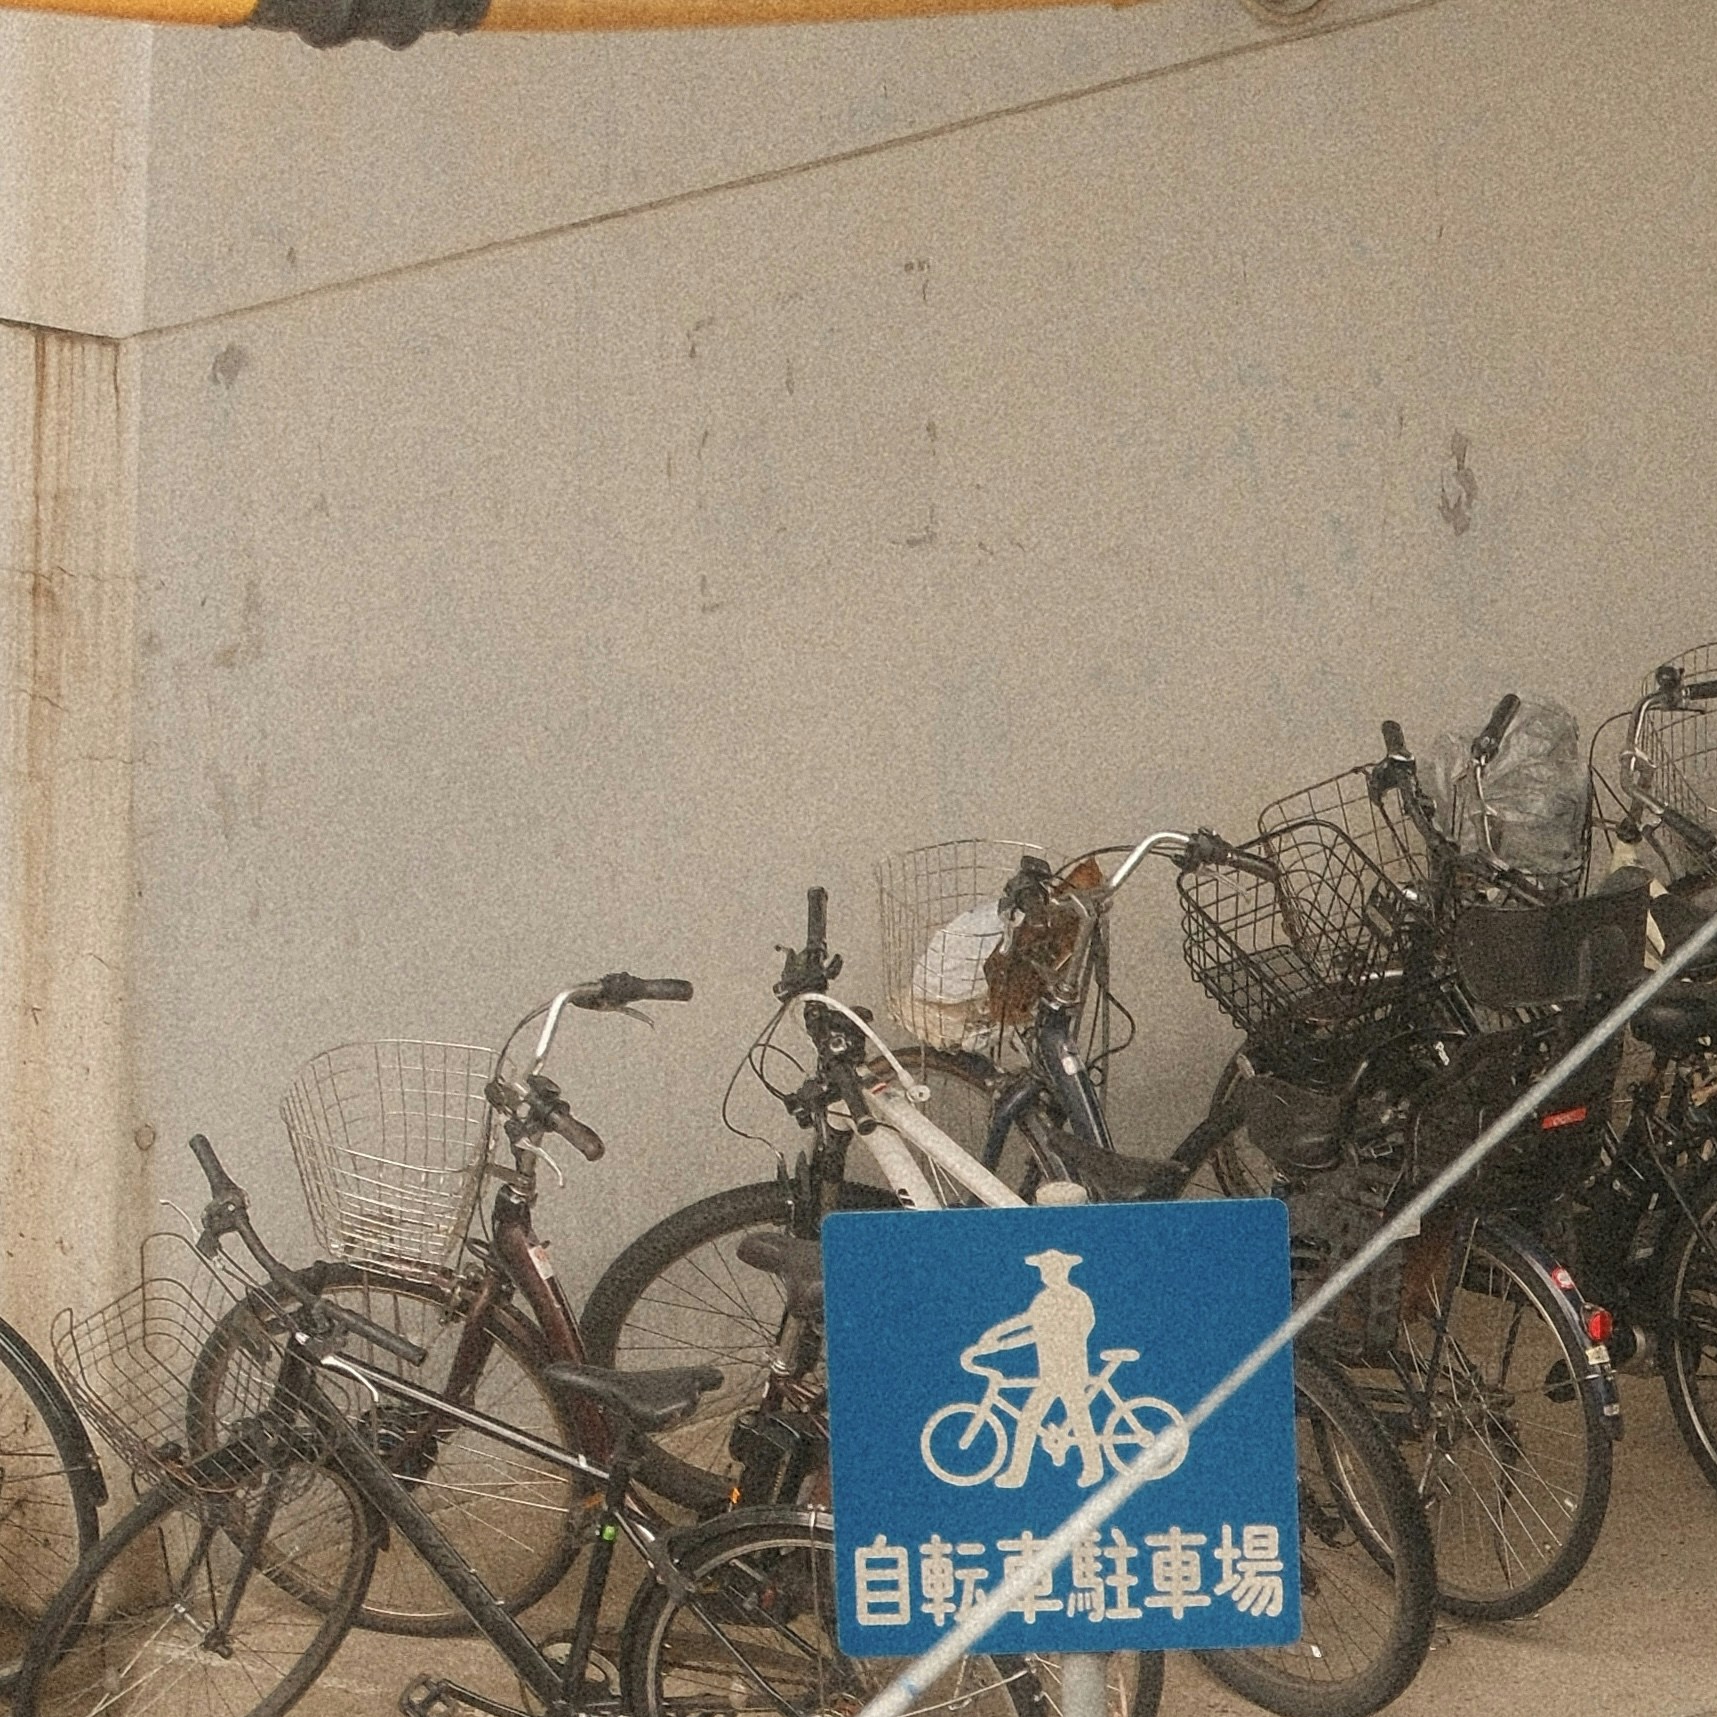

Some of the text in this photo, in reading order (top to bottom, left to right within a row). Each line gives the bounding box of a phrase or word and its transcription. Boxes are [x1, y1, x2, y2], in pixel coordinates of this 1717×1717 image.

[854, 1525, 1284, 1627] 自転車駐車場
